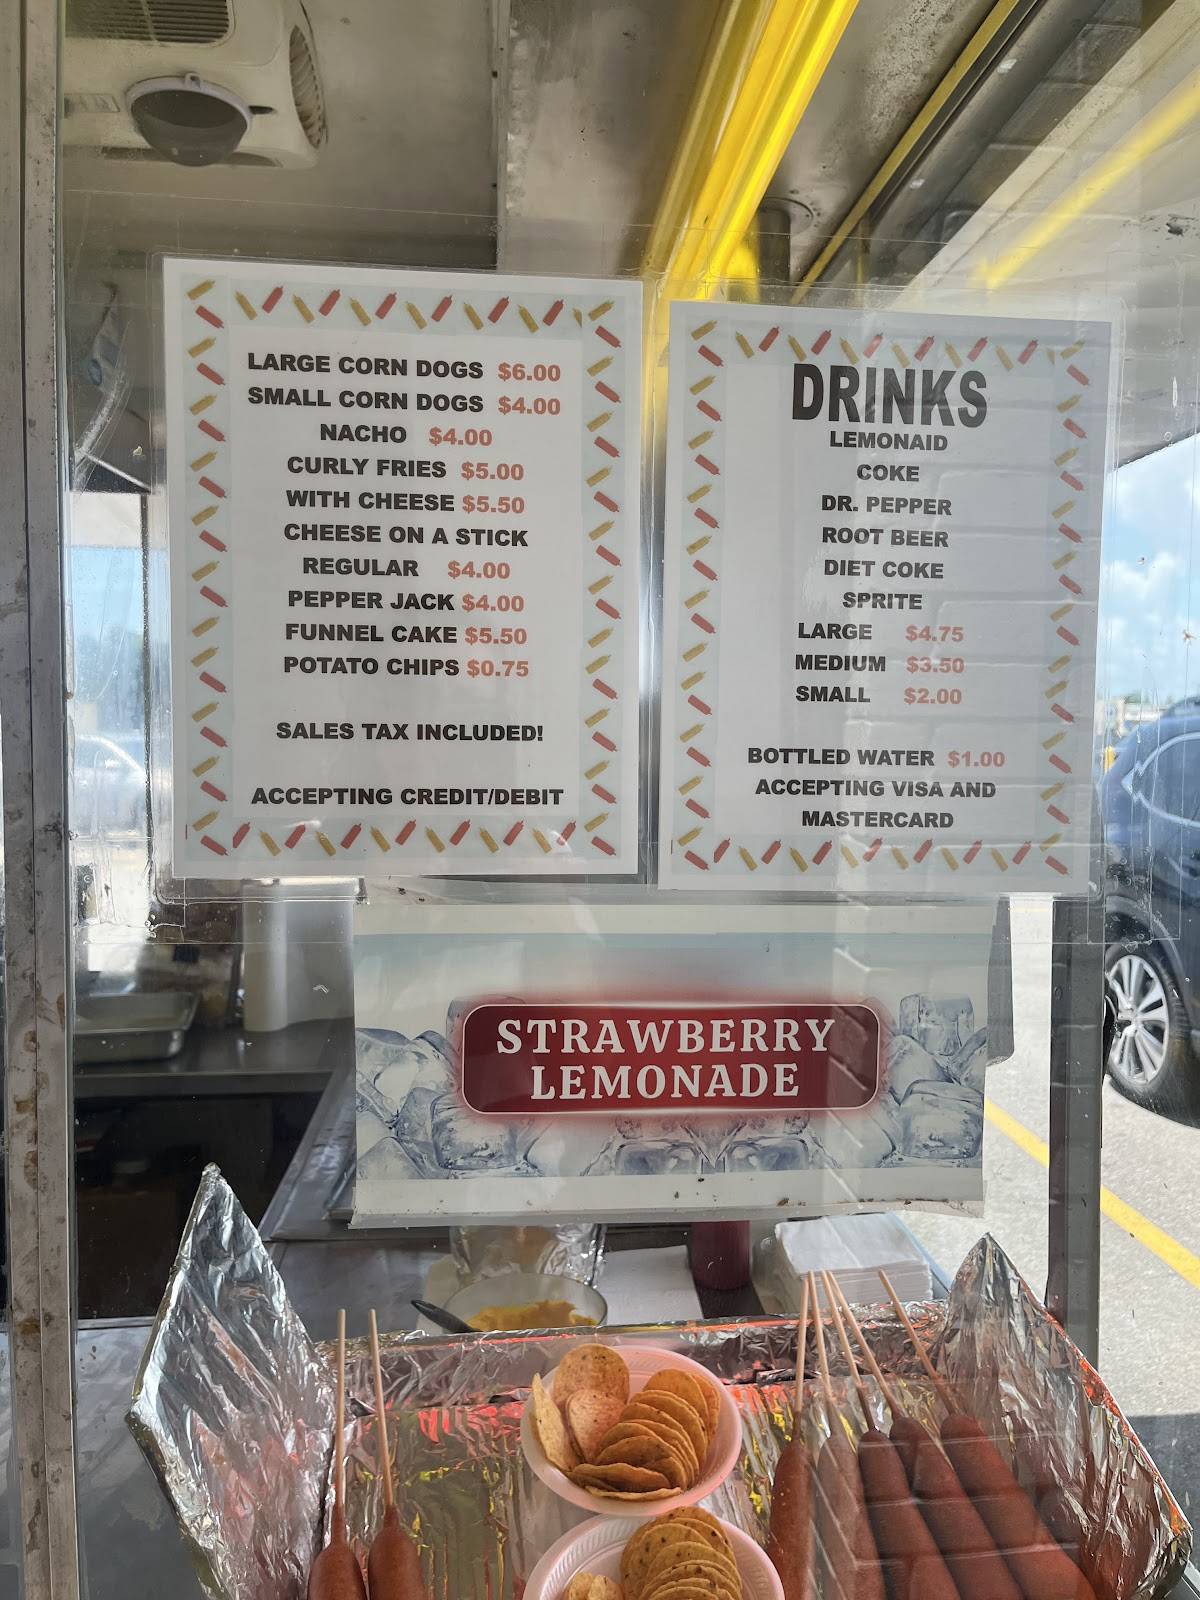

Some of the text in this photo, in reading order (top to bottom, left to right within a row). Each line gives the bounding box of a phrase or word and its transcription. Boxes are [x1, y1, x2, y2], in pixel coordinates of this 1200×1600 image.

[248, 353, 560, 383] LARGE CORN DOGS $6.00
[248, 387, 560, 417] SMALL CORN DOGS $4.00
[792, 363, 989, 428] DRINKS
[321, 424, 492, 447] NACHO $4.00
[830, 431, 947, 450] LEMONAID
[288, 456, 524, 482] CURLY FRIES $5.00
[857, 464, 919, 481] COKE
[286, 490, 525, 515] WITH CHEESE $5.50
[822, 495, 951, 515] DR. PEPPER
[284, 524, 528, 546] CHEESE ON A STICK
[822, 527, 948, 547] ROOT BEER
[303, 558, 510, 580] REGULAR $4.00
[824, 560, 943, 579] DIET COKE
[289, 591, 524, 614] PEPPER JACK $4.00
[843, 592, 922, 609] SPRITE
[286, 624, 527, 646] FUNNEL CAKE $5.50
[798, 623, 964, 644] LARGE $4.75
[284, 657, 529, 679] POTATO CHIPS $0.75
[796, 654, 965, 675] MEDIUM $3.50
[796, 686, 963, 706] SMALL $2.00
[277, 722, 543, 741] SALES TAX INCLUDED!
[748, 748, 1005, 768] BOTTLED WATER $1.00
[251, 788, 564, 805] ACCEPTING CREDIT/DEBIT
[755, 779, 996, 797] ACCEPTING VISA AND
[802, 811, 953, 828] MASTERCARD
[498, 1019, 834, 1053] STRAWBERRY
[531, 1064, 798, 1099] LEMONADE
